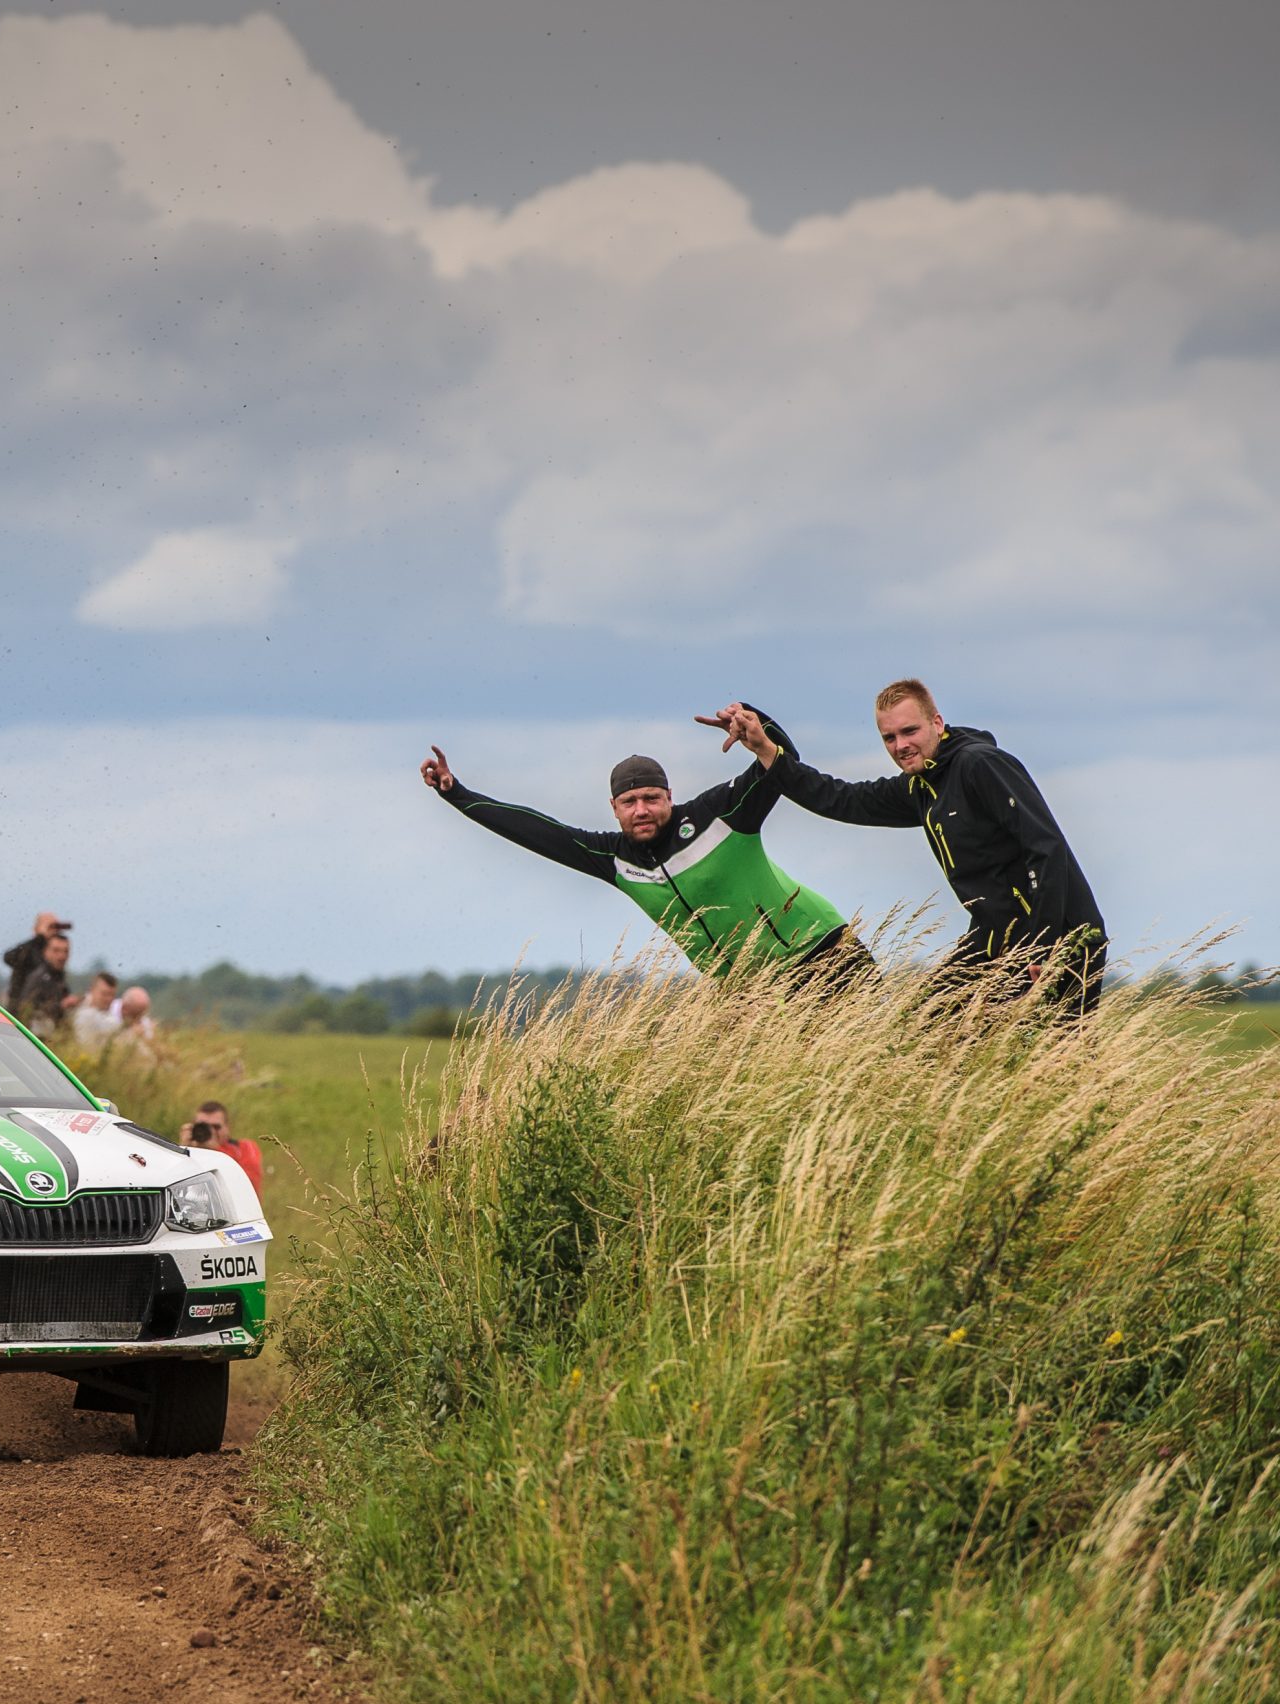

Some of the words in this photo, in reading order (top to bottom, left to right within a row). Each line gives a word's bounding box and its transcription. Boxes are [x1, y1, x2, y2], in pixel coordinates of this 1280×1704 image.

[201, 1254, 258, 1280] ŠKODA
[213, 1302, 237, 1315] EDGE
[218, 1329, 247, 1344] R5
